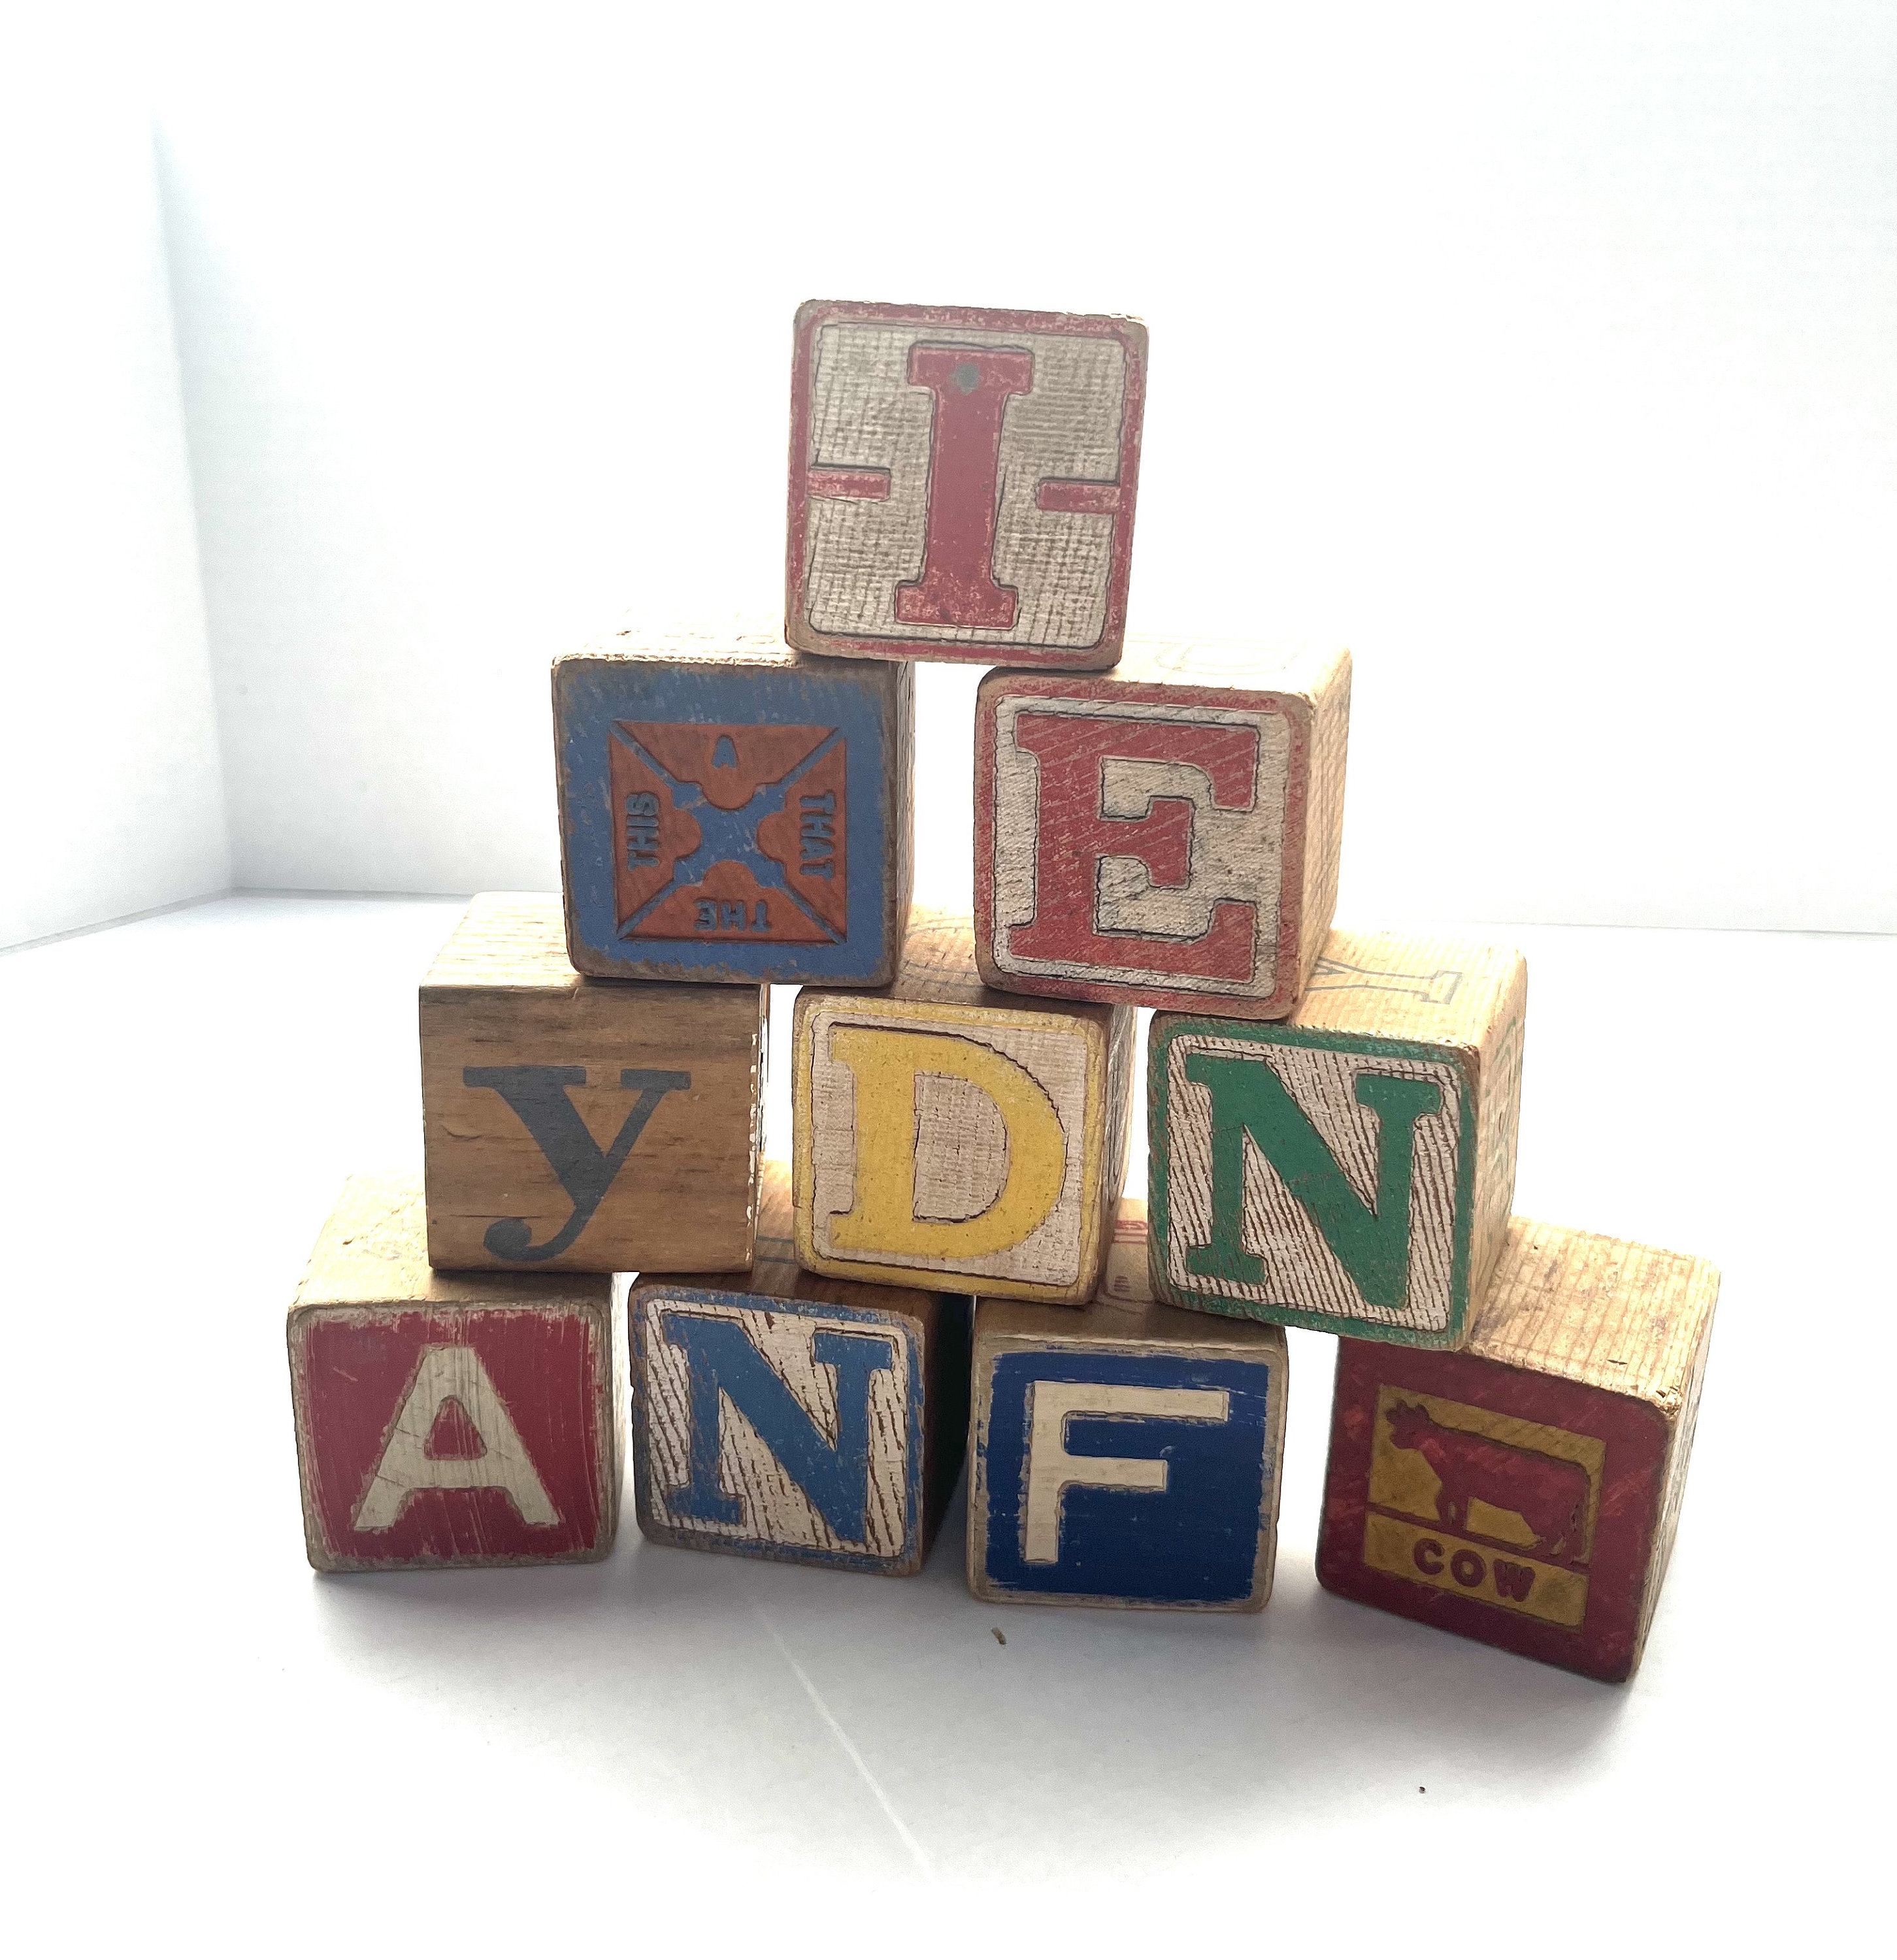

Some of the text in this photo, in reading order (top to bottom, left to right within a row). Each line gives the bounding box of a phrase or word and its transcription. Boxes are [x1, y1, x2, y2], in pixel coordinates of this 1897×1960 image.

[896, 346, 1034, 629] I
[627, 793, 659, 870] THIS
[714, 736, 739, 768] A
[800, 792, 834, 880] THAT
[696, 900, 771, 932] THE
[1008, 712, 1259, 982] E
[831, 1026, 1066, 1258] D
[1185, 1053, 1442, 1308] N
[354, 1346, 562, 1531] A
[663, 1313, 893, 1542] N
[1025, 1380, 1230, 1564] F
[1413, 1538, 1536, 1603] COW
